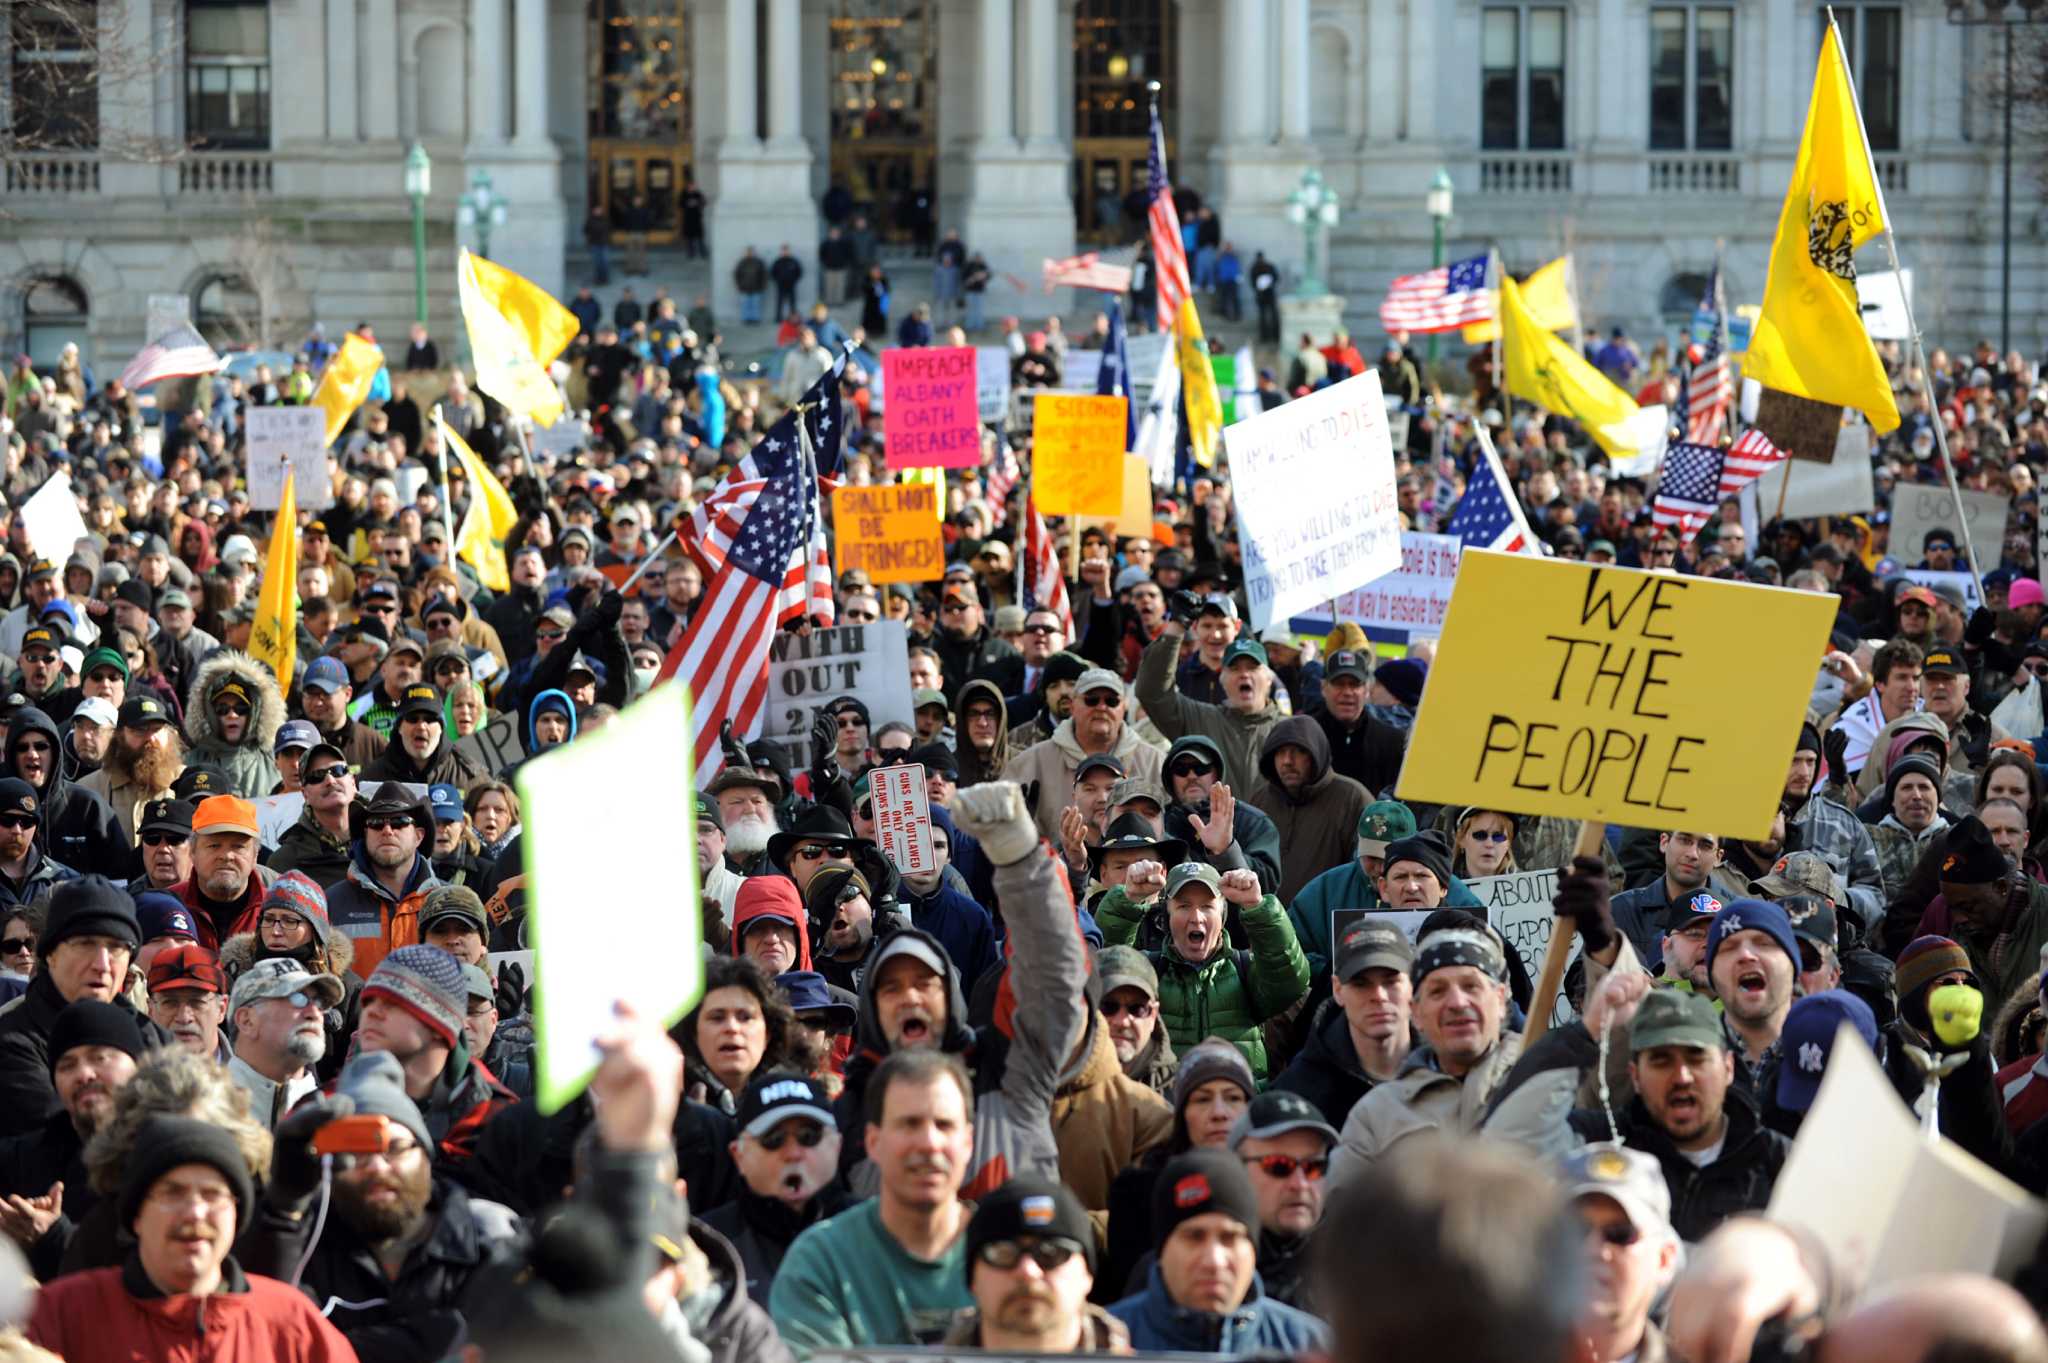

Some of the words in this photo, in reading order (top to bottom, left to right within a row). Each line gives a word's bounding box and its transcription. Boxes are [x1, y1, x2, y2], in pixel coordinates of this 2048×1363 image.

[893, 354, 974, 379] IMPEACH
[895, 381, 967, 402] ALBANY
[904, 405, 955, 427] OATH
[892, 427, 978, 455] BREAKERS
[897, 485, 936, 512] NOT
[859, 516, 885, 538] BE
[1580, 568, 1689, 642] WE
[769, 626, 865, 663] WITH
[782, 660, 861, 697] OUT
[1546, 635, 1683, 720] THE
[1473, 713, 1707, 813] PEOPLE
[875, 773, 889, 809] OUTLAWS
[899, 771, 912, 796] GUNS
[880, 810, 891, 831] WILL
[892, 809, 904, 832] ONLY
[904, 801, 914, 817] ARE
[916, 816, 927, 825] IF
[882, 831, 894, 850] HAVE
[905, 821, 921, 869] OUTLAWED
[1488, 872, 1560, 907] ABOUT
[1798, 1041, 1824, 1073] NY
[760, 1079, 814, 1105] NRA
